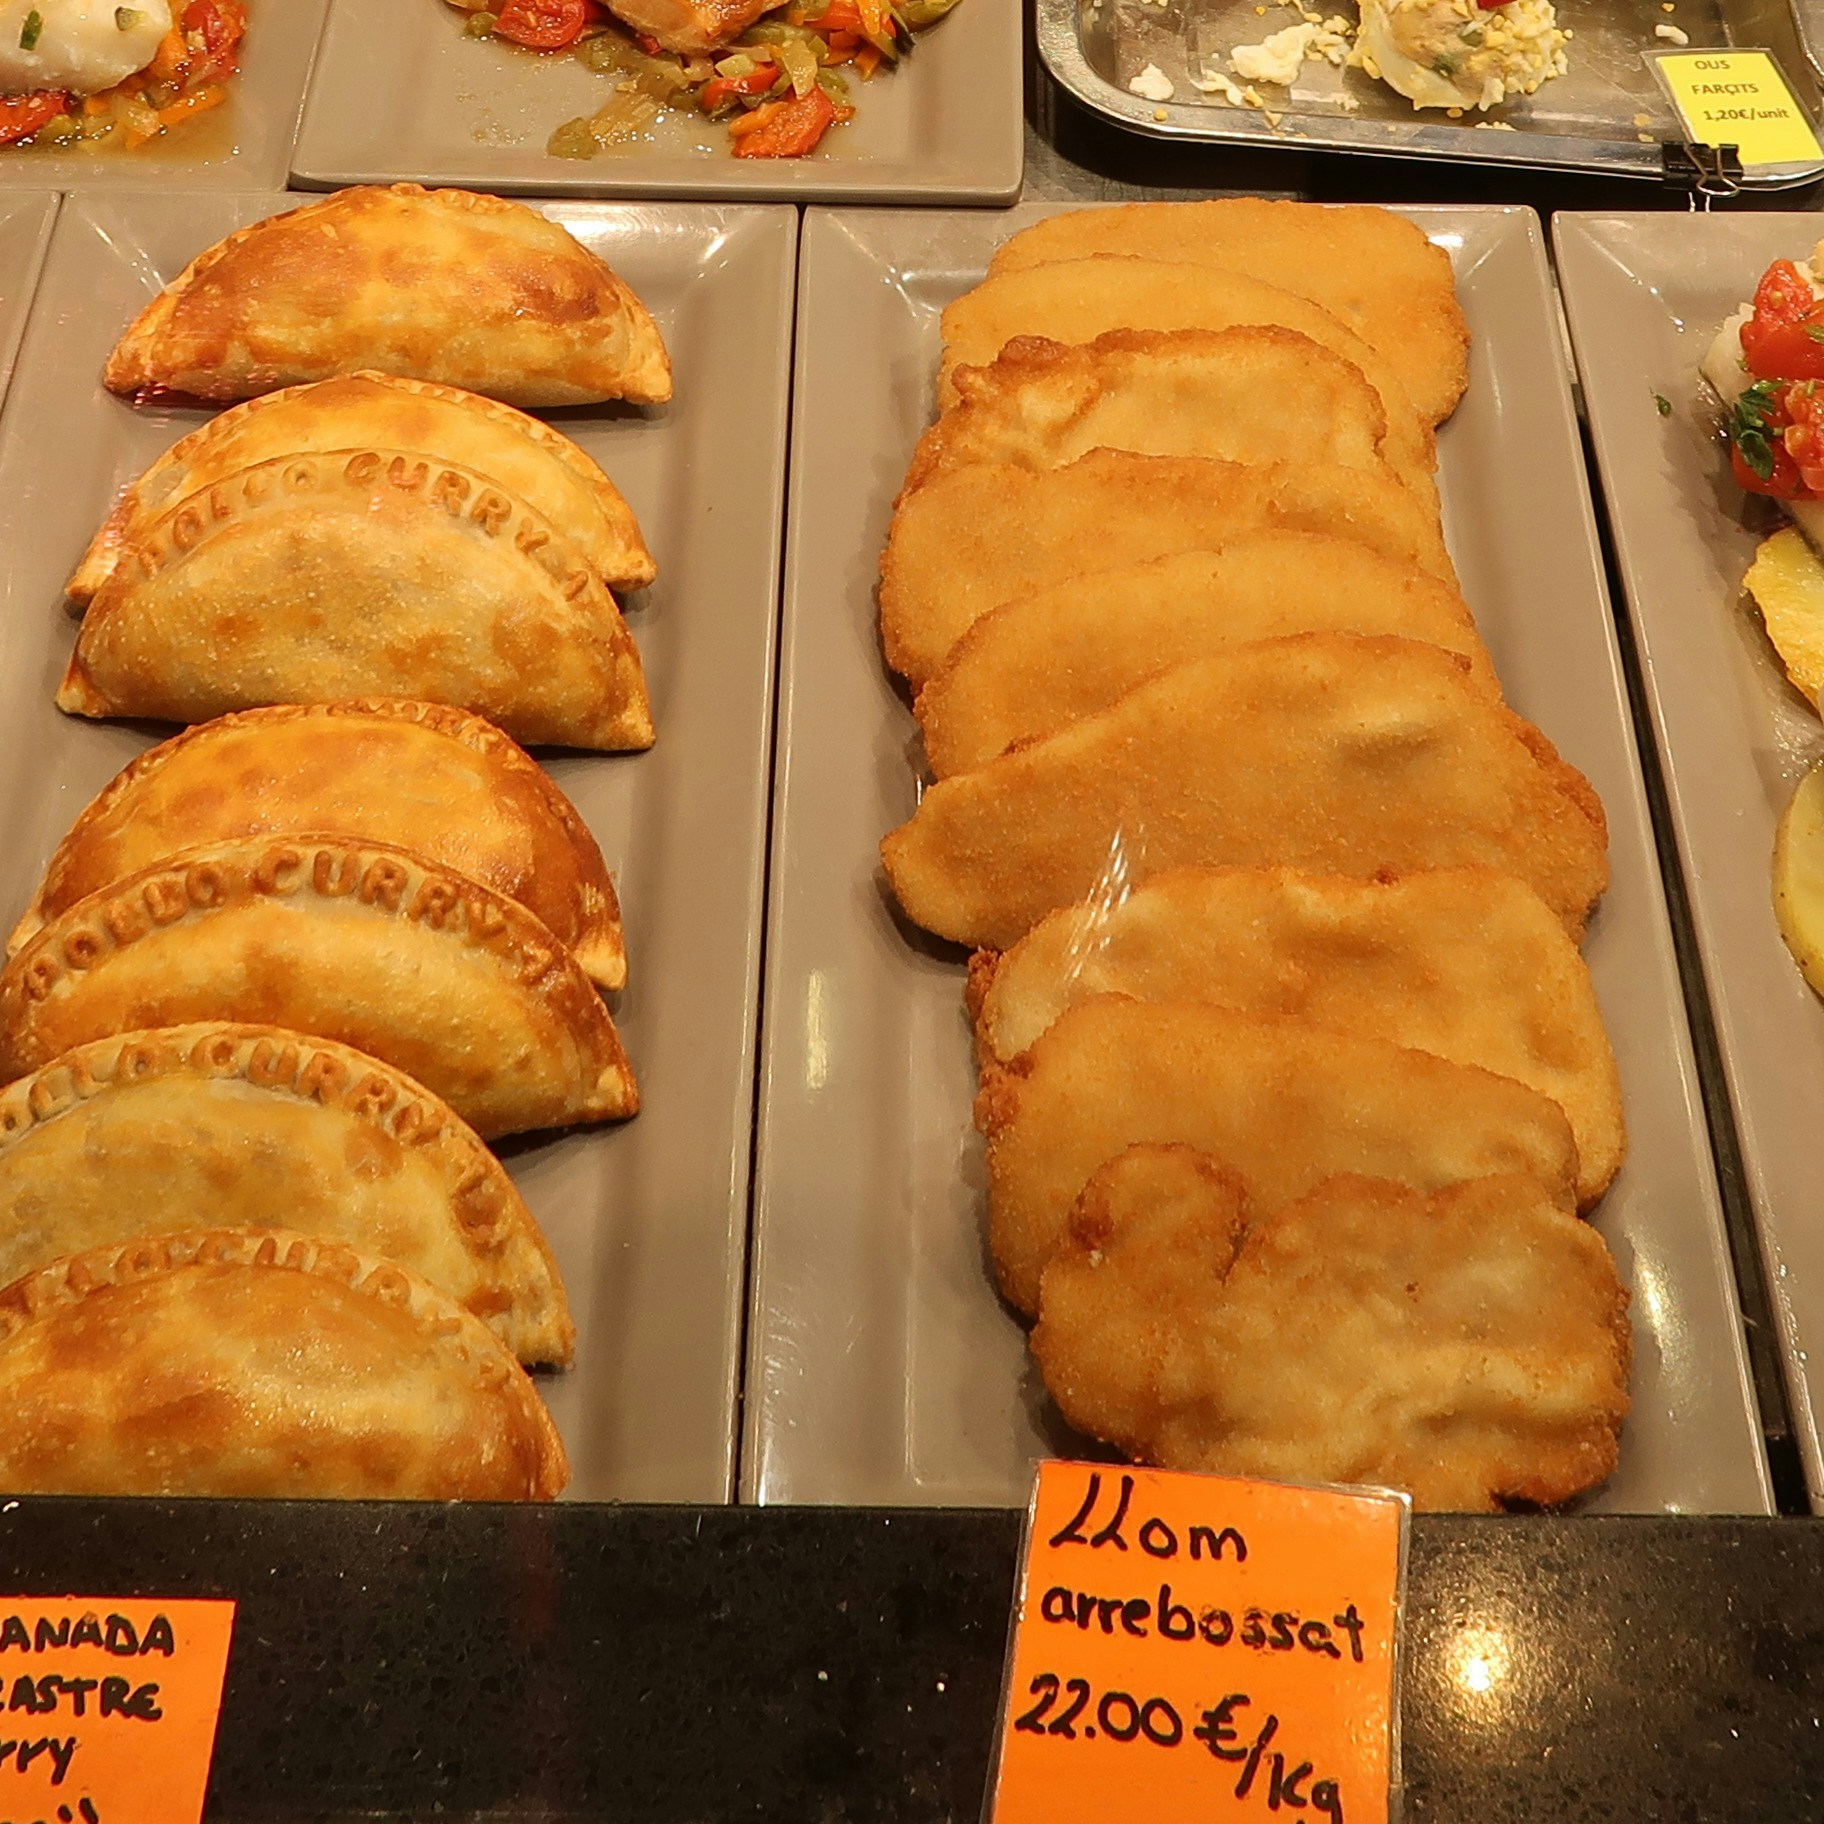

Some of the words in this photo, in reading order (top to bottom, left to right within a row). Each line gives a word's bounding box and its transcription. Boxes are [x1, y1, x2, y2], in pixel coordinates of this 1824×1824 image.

[1694, 59, 1731, 71] OUS
[1691, 82, 1760, 96] FARÇITS
[1703, 107, 1791, 121] 1,20€/unit
[1040, 1583, 1365, 1663] arrebossat
